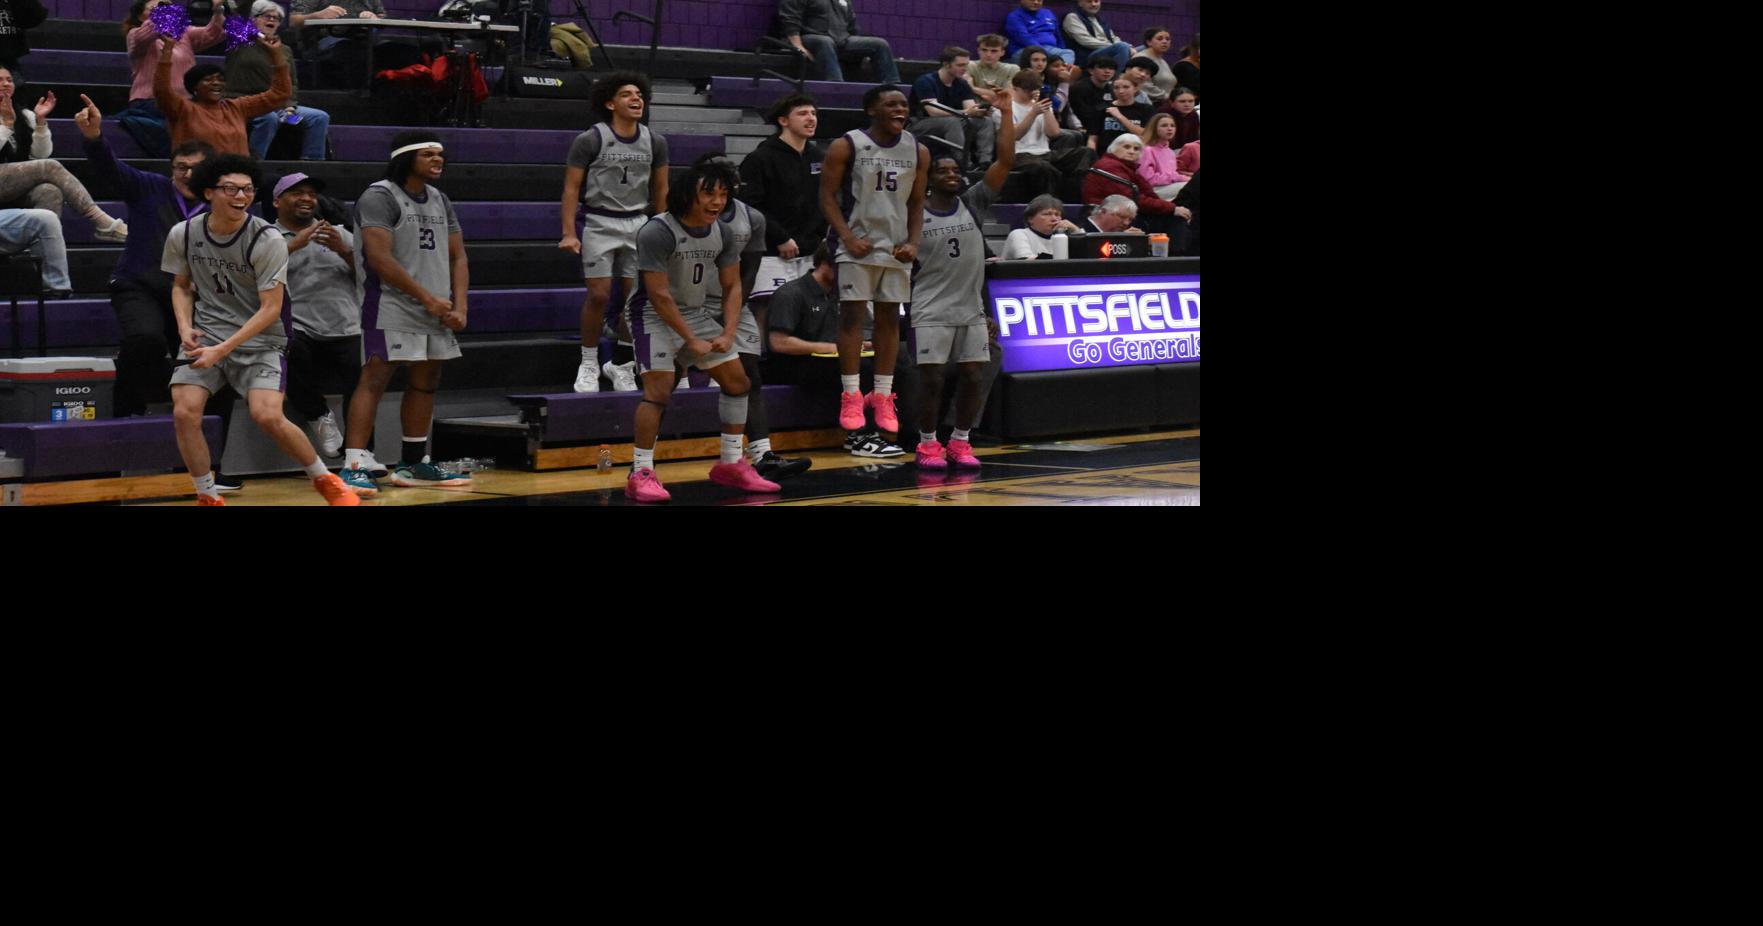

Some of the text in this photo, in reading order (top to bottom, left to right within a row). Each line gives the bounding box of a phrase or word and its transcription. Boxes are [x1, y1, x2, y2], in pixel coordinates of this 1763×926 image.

[522, 76, 558, 86] MILLER
[620, 166, 628, 185] 1
[875, 170, 898, 192] 15
[923, 222, 974, 239] PITTSFIELD
[674, 249, 718, 261] PITTSFIEL
[947, 237, 960, 258] 3
[1108, 243, 1127, 255] POSS
[693, 262, 704, 285] 0
[211, 272, 235, 296] 11
[995, 291, 1200, 338] PITTSFIELD
[1067, 338, 1102, 365] Go
[55, 386, 91, 395] IGLOO
